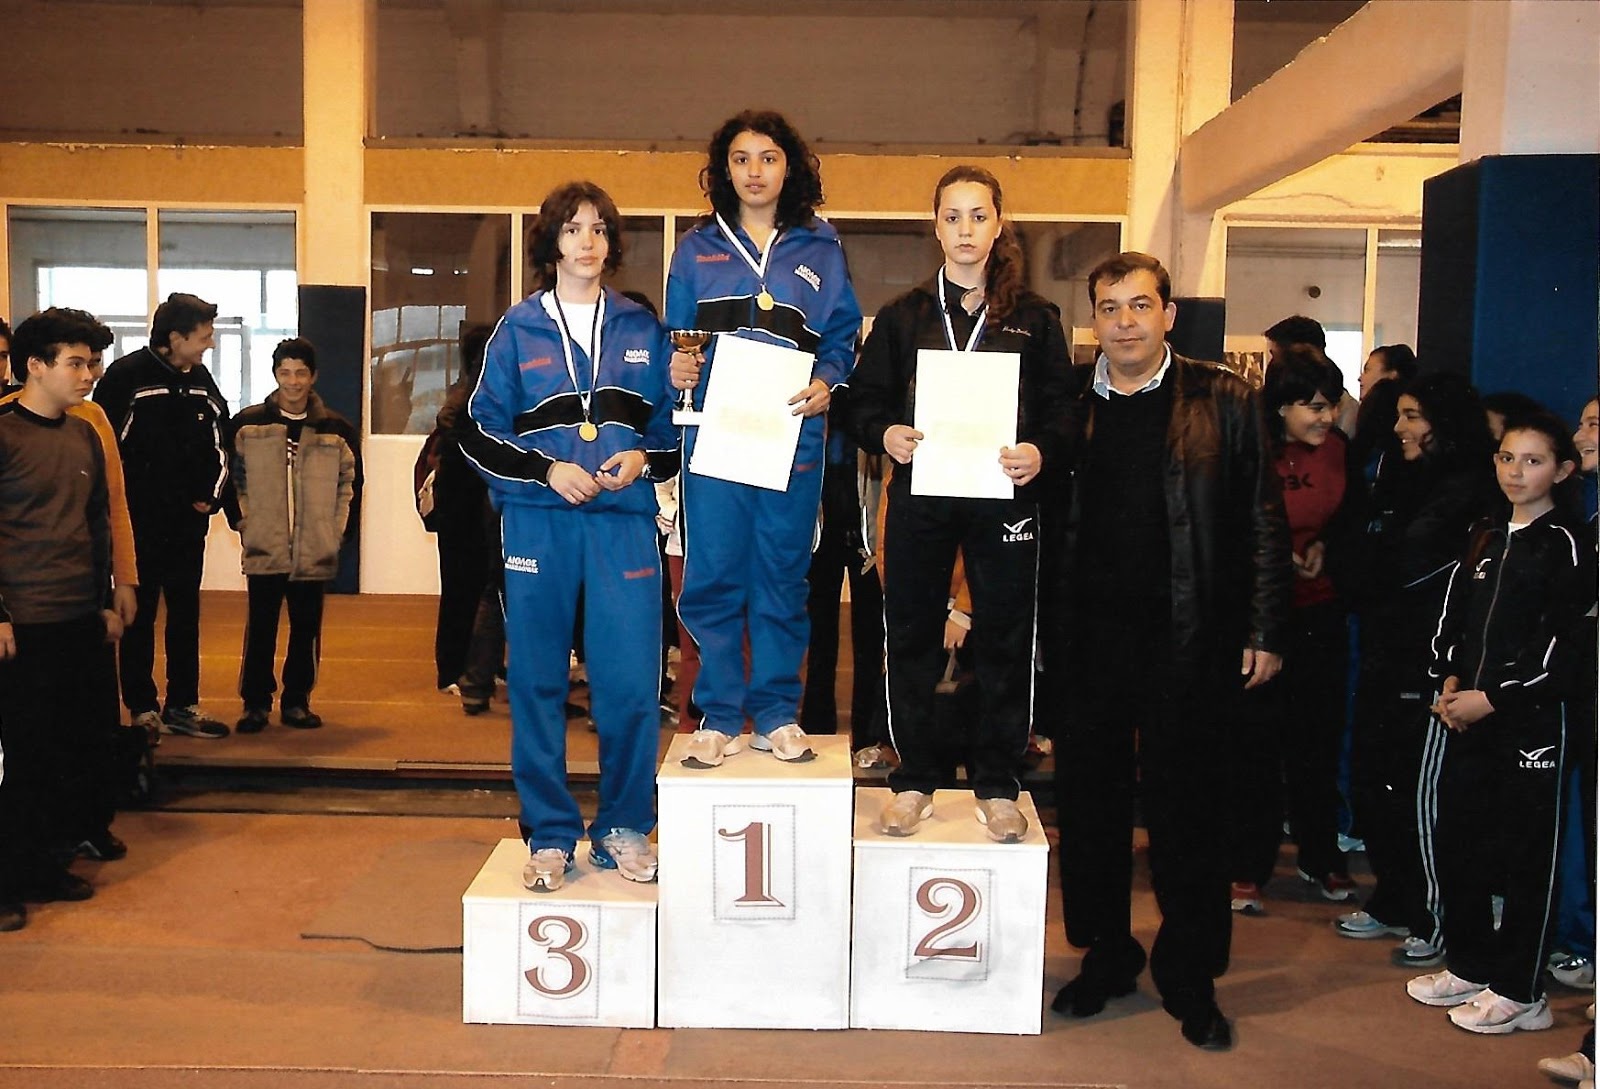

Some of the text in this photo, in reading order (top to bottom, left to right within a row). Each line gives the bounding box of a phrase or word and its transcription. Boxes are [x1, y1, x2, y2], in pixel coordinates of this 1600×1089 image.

[1003, 532, 1034, 542] LEGEA
[1519, 760, 1556, 768] LEGEA
[718, 821, 786, 907] 1
[524, 915, 592, 1000] 3
[914, 877, 982, 963] 2
